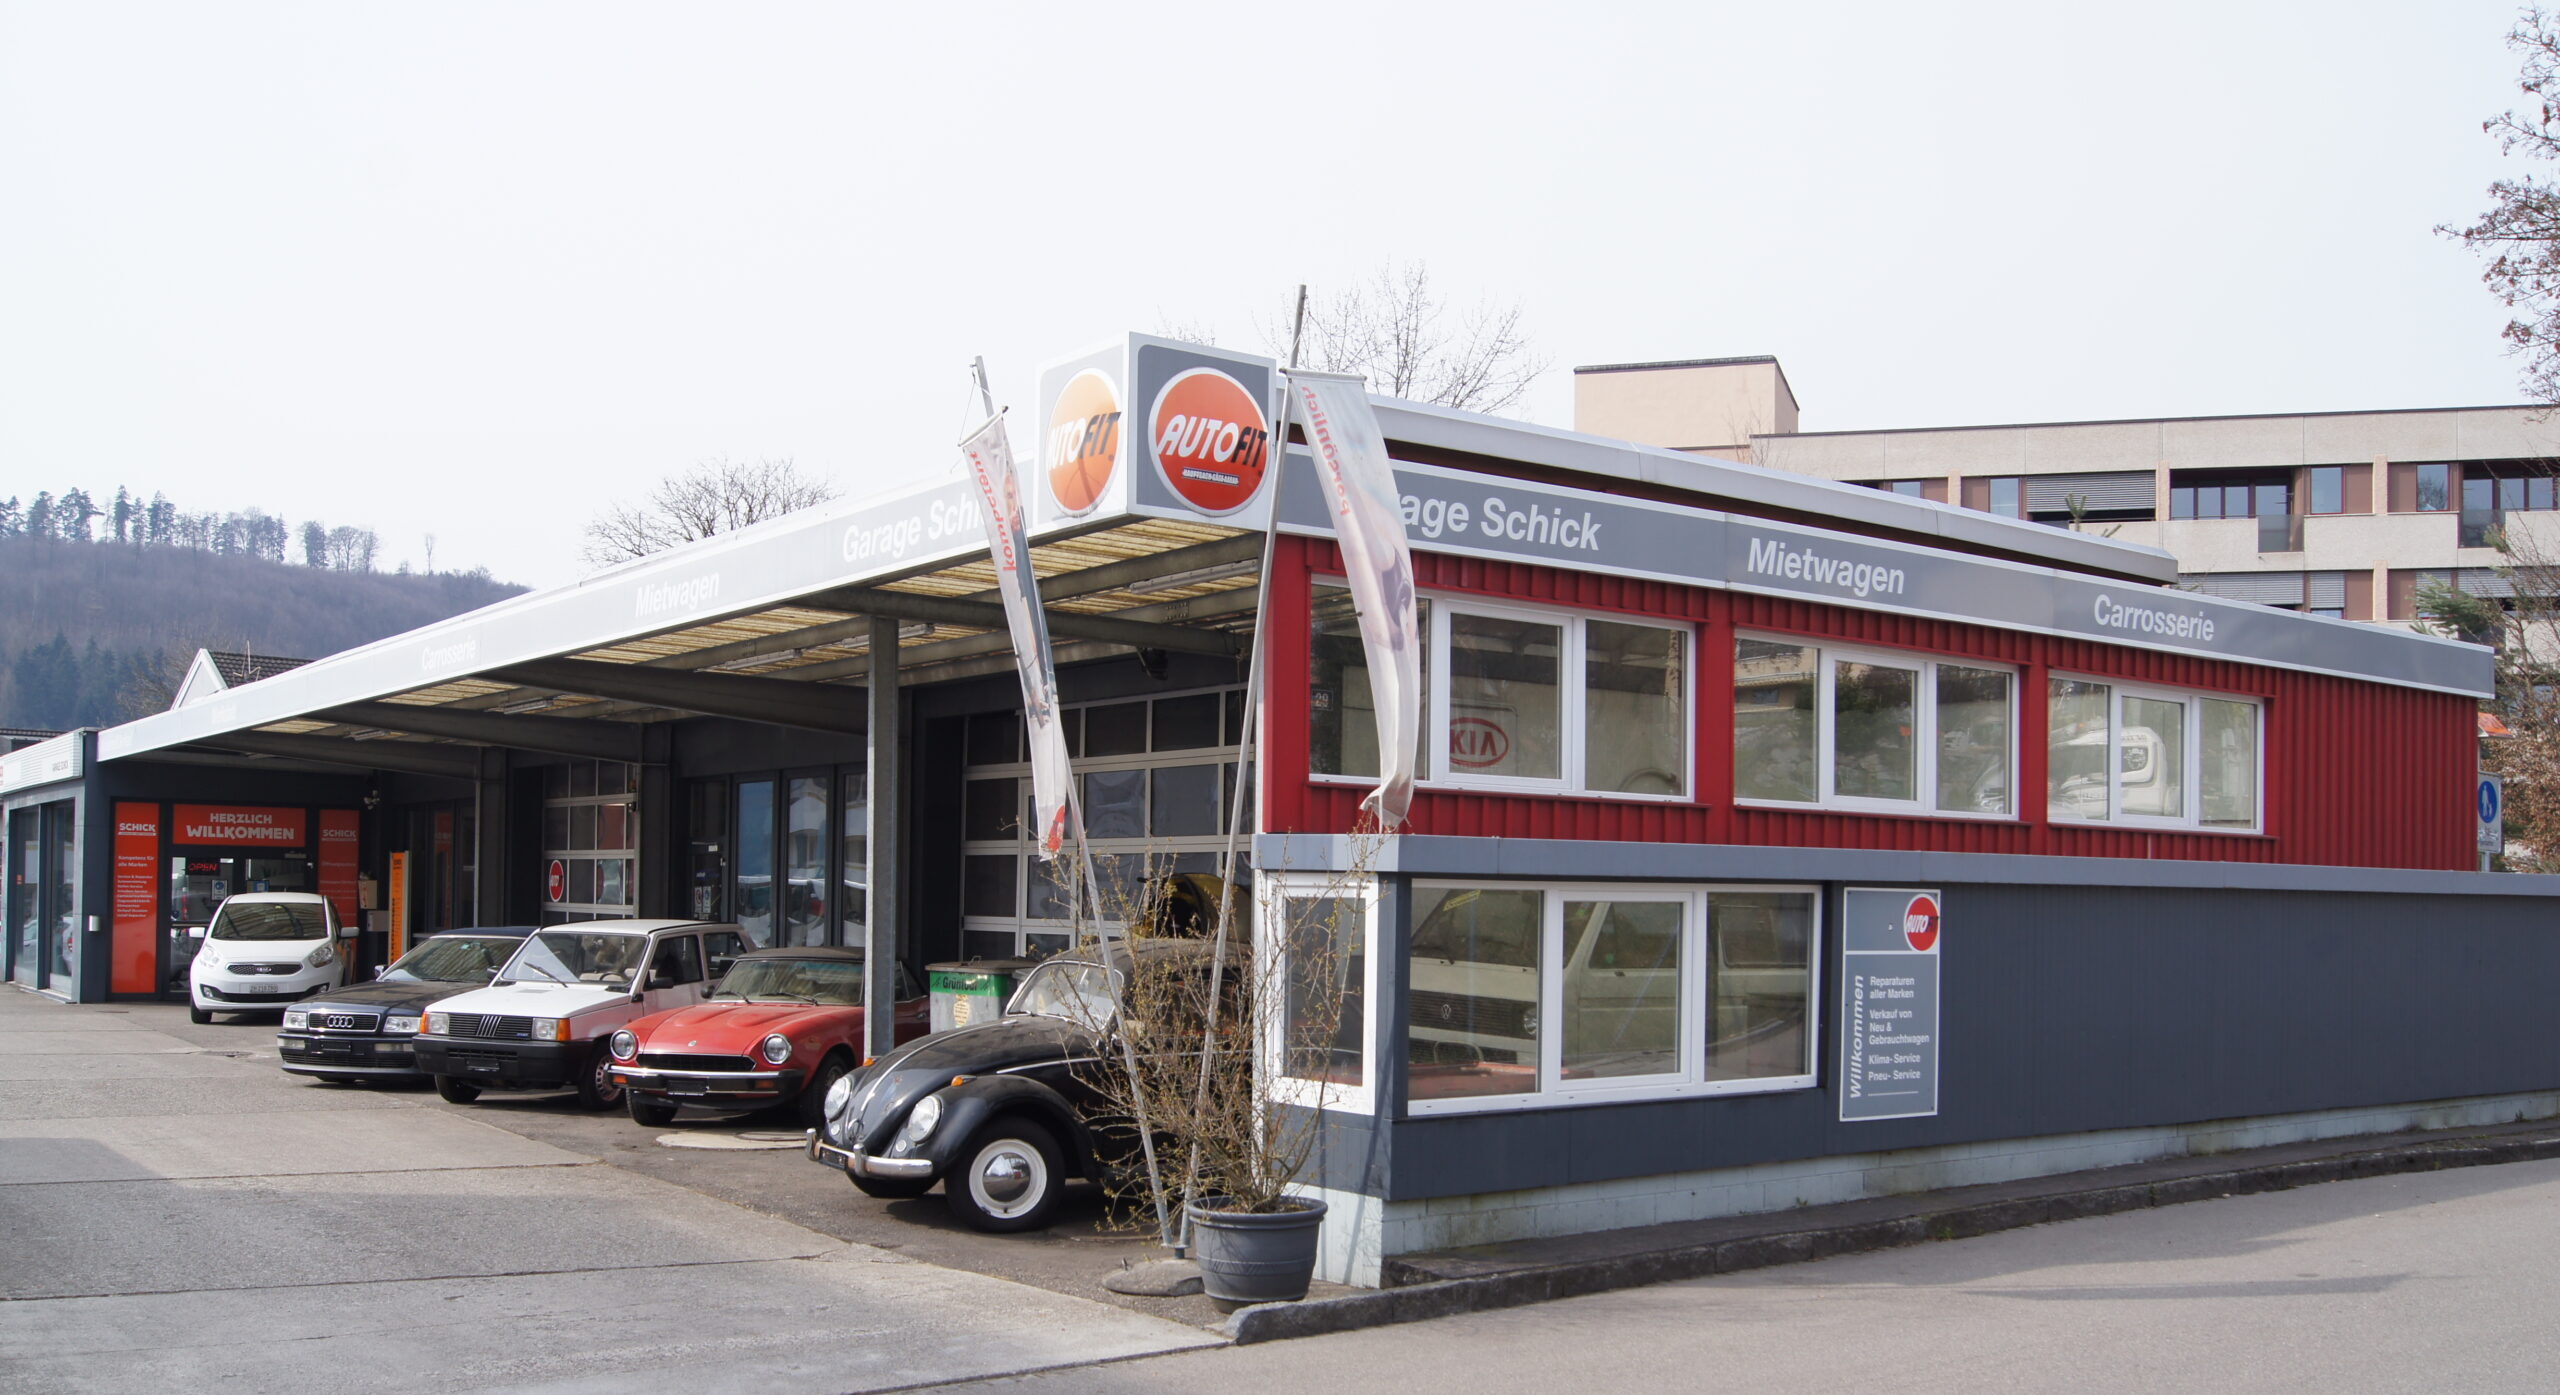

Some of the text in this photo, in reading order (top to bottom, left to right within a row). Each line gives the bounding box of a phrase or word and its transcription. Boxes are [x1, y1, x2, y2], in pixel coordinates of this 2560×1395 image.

[843, 493, 986, 562] Garage Schi
[1398, 493, 1602, 551] age Schick
[1747, 536, 1905, 597] Mietwagen
[635, 571, 720, 617] Mietwagen
[2093, 593, 2216, 642] Carrosserie
[422, 634, 477, 671] Carrosserie
[1450, 728, 1497, 756] KIA
[210, 813, 272, 824] HERZLICH
[119, 823, 156, 832] SCHICK
[186, 825, 295, 840] WILLKOMMEN
[322, 829, 356, 838] SCHICK
[1870, 976, 1915, 987] Reparaturen
[1870, 989, 1914, 999] aller Marken
[1869, 1009, 1912, 1019] Verkauf von
[1869, 1022, 1892, 1032] Neu &
[1850, 975, 1864, 1098] Willkommen
[1869, 1034, 1930, 1046] Gebrauchtwagen
[1894, 1053, 1920, 1064] Service
[1893, 1069, 1920, 1080] Service
